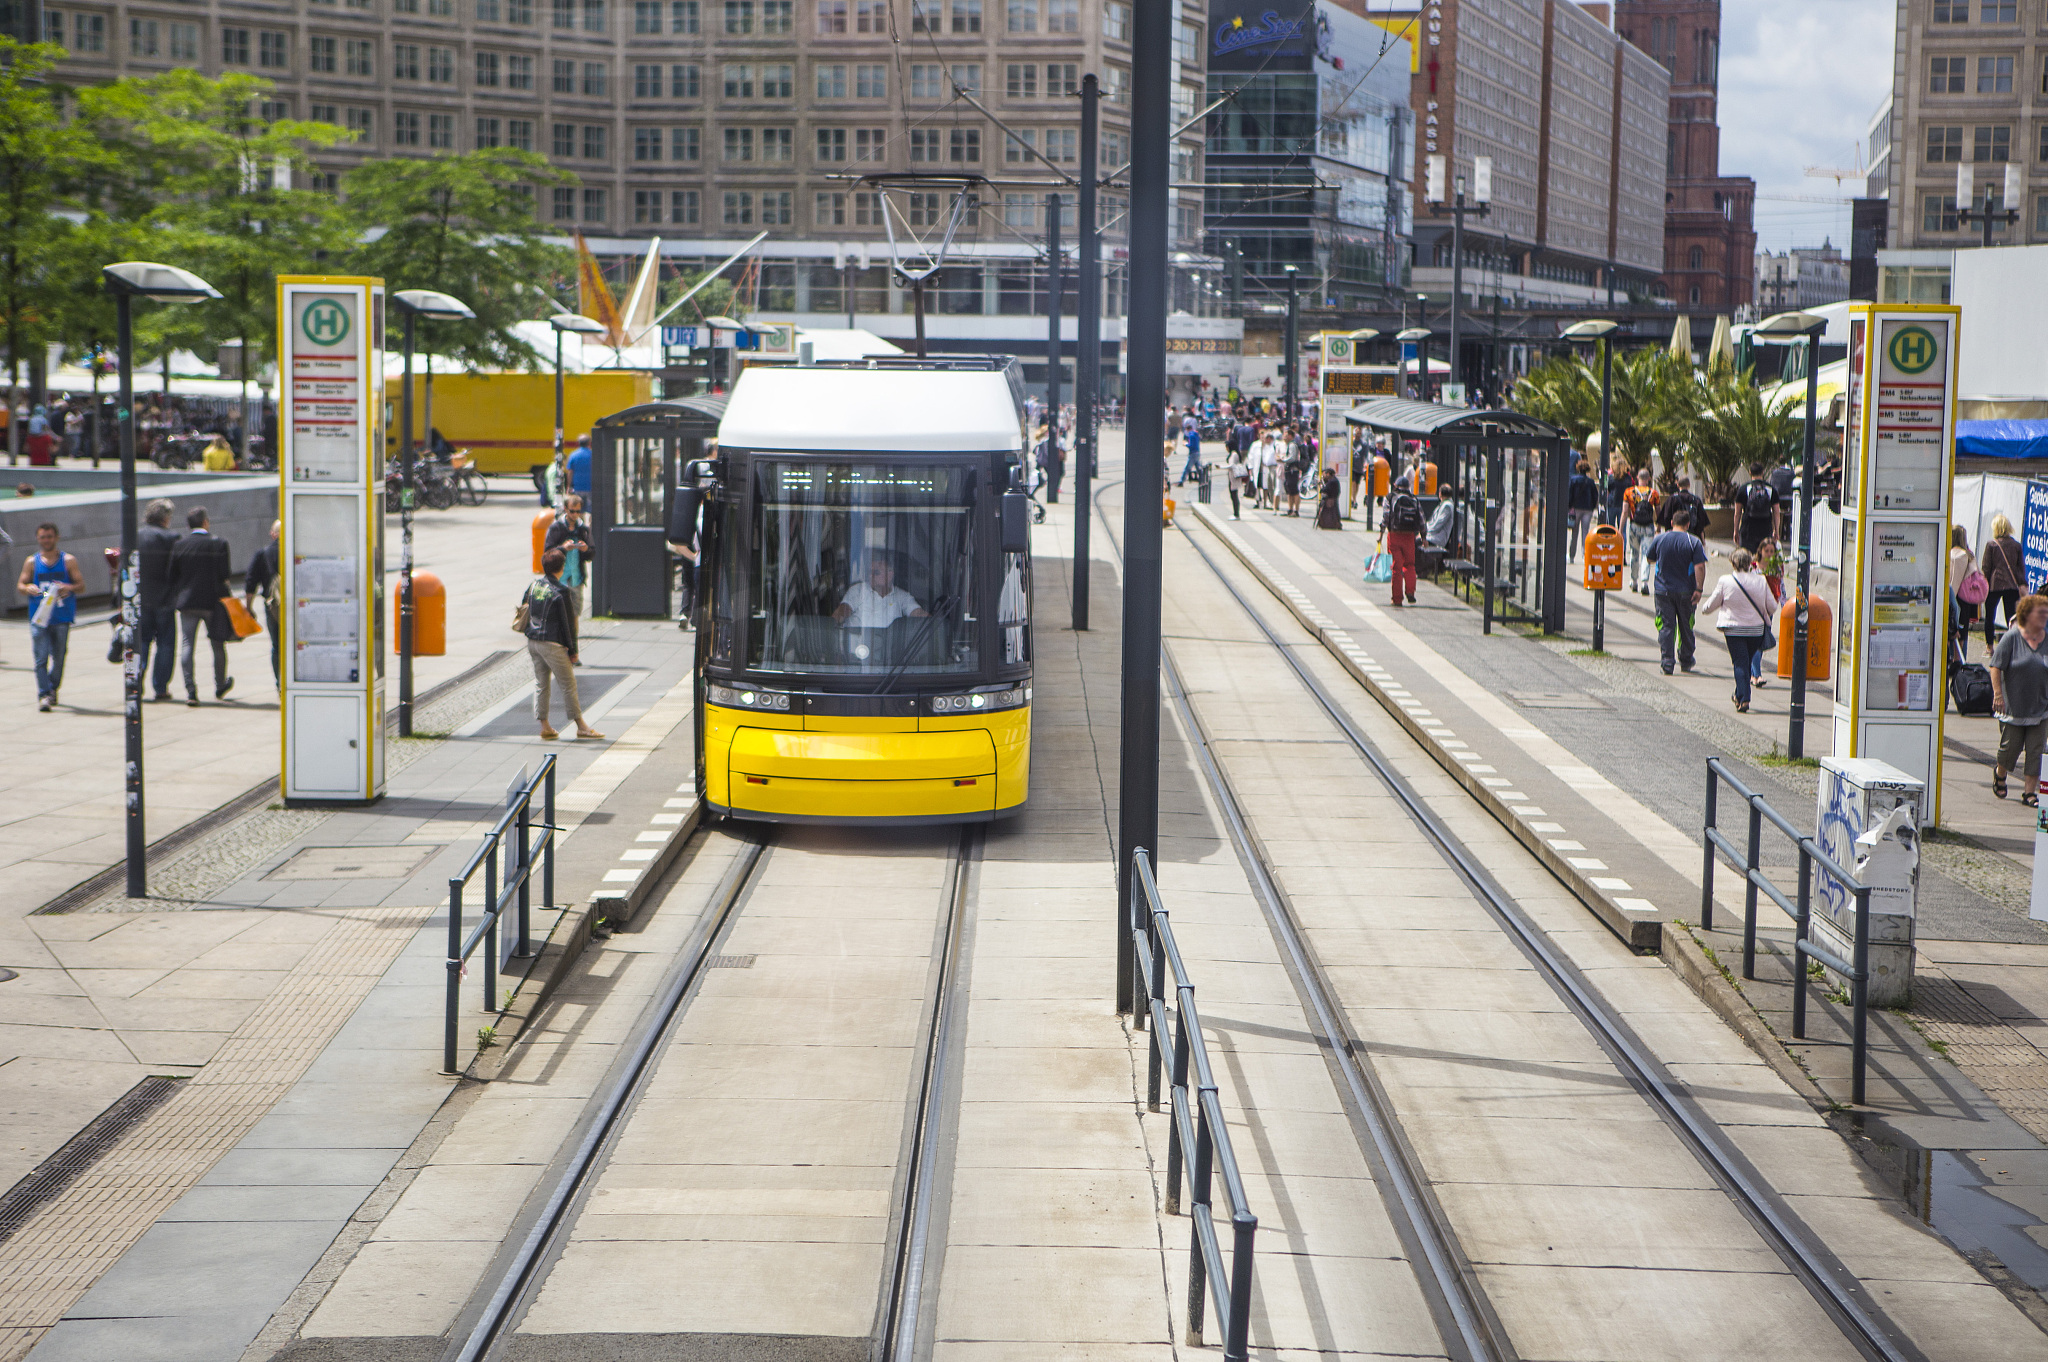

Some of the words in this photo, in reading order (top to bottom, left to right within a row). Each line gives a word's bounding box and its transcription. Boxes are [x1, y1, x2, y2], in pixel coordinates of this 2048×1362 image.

[1215, 11, 1305, 48] CineStar
[314, 309, 337, 336] H
[663, 327, 678, 346] U
[1173, 339, 1188, 351] 20
[1190, 340, 1202, 351] 21
[1204, 340, 1217, 352] 22
[1902, 337, 1925, 363] H
[1885, 389, 1896, 397] M4
